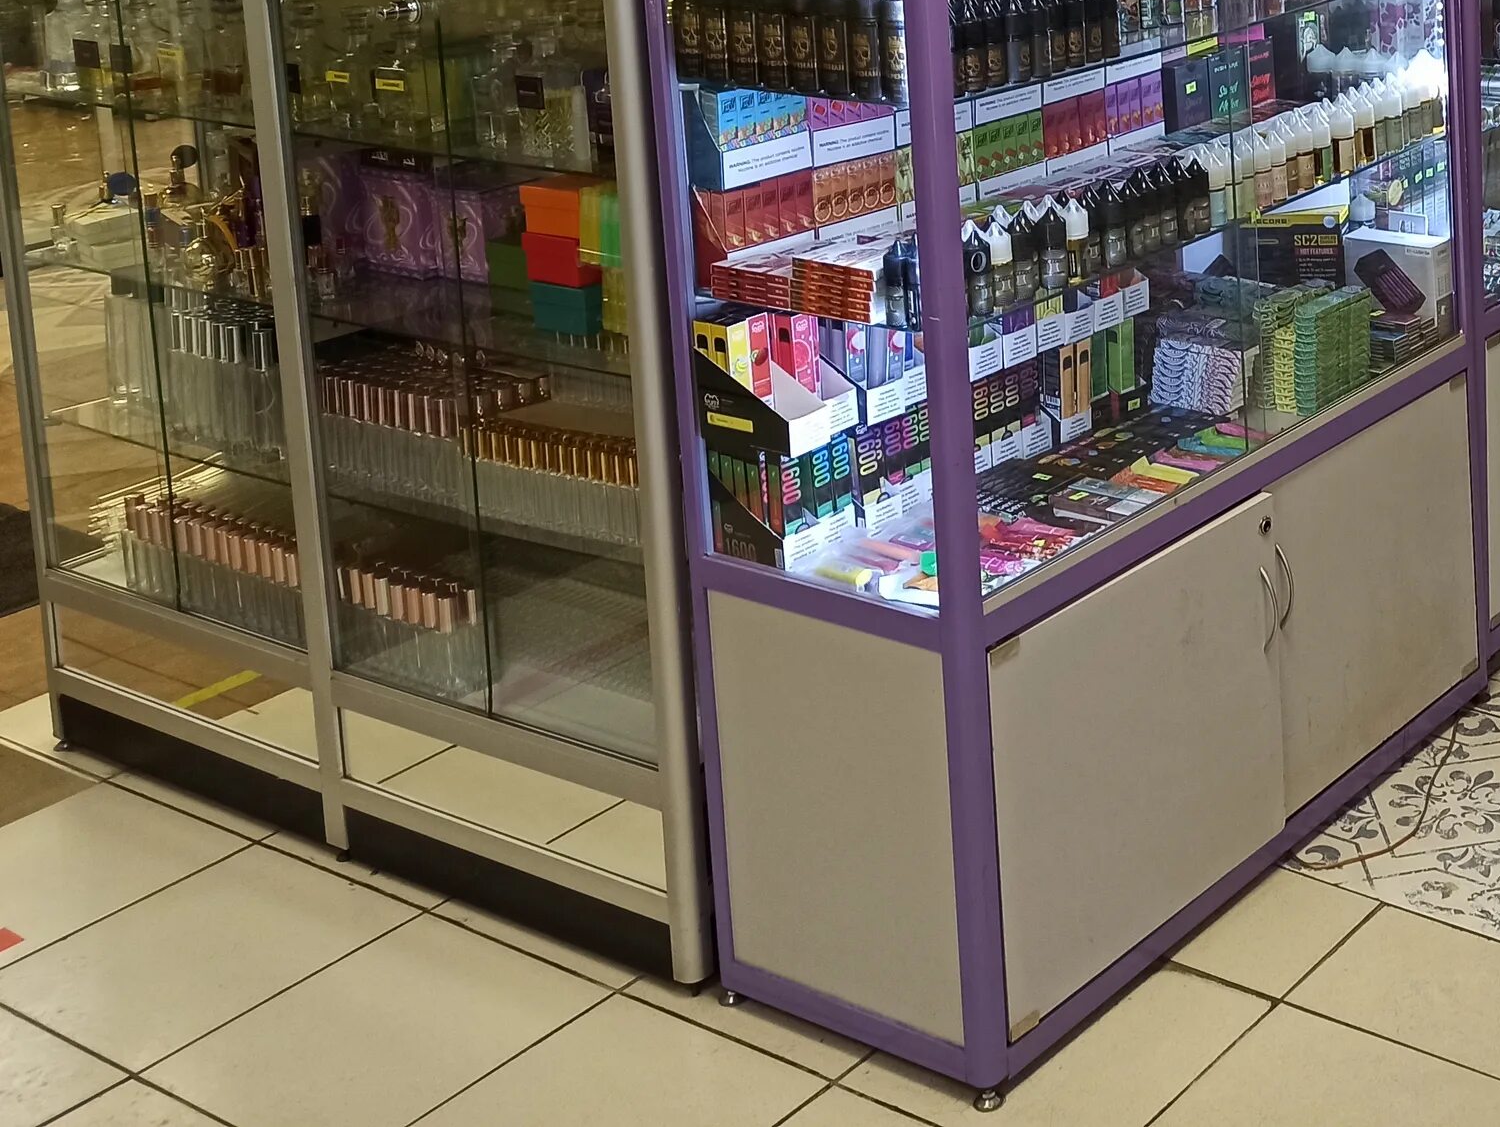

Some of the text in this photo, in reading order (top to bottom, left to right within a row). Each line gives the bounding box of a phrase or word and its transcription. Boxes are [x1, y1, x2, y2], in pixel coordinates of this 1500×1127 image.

[832, 433, 850, 480] 1600
[857, 430, 878, 476] 1600
[781, 458, 801, 505] 1600
